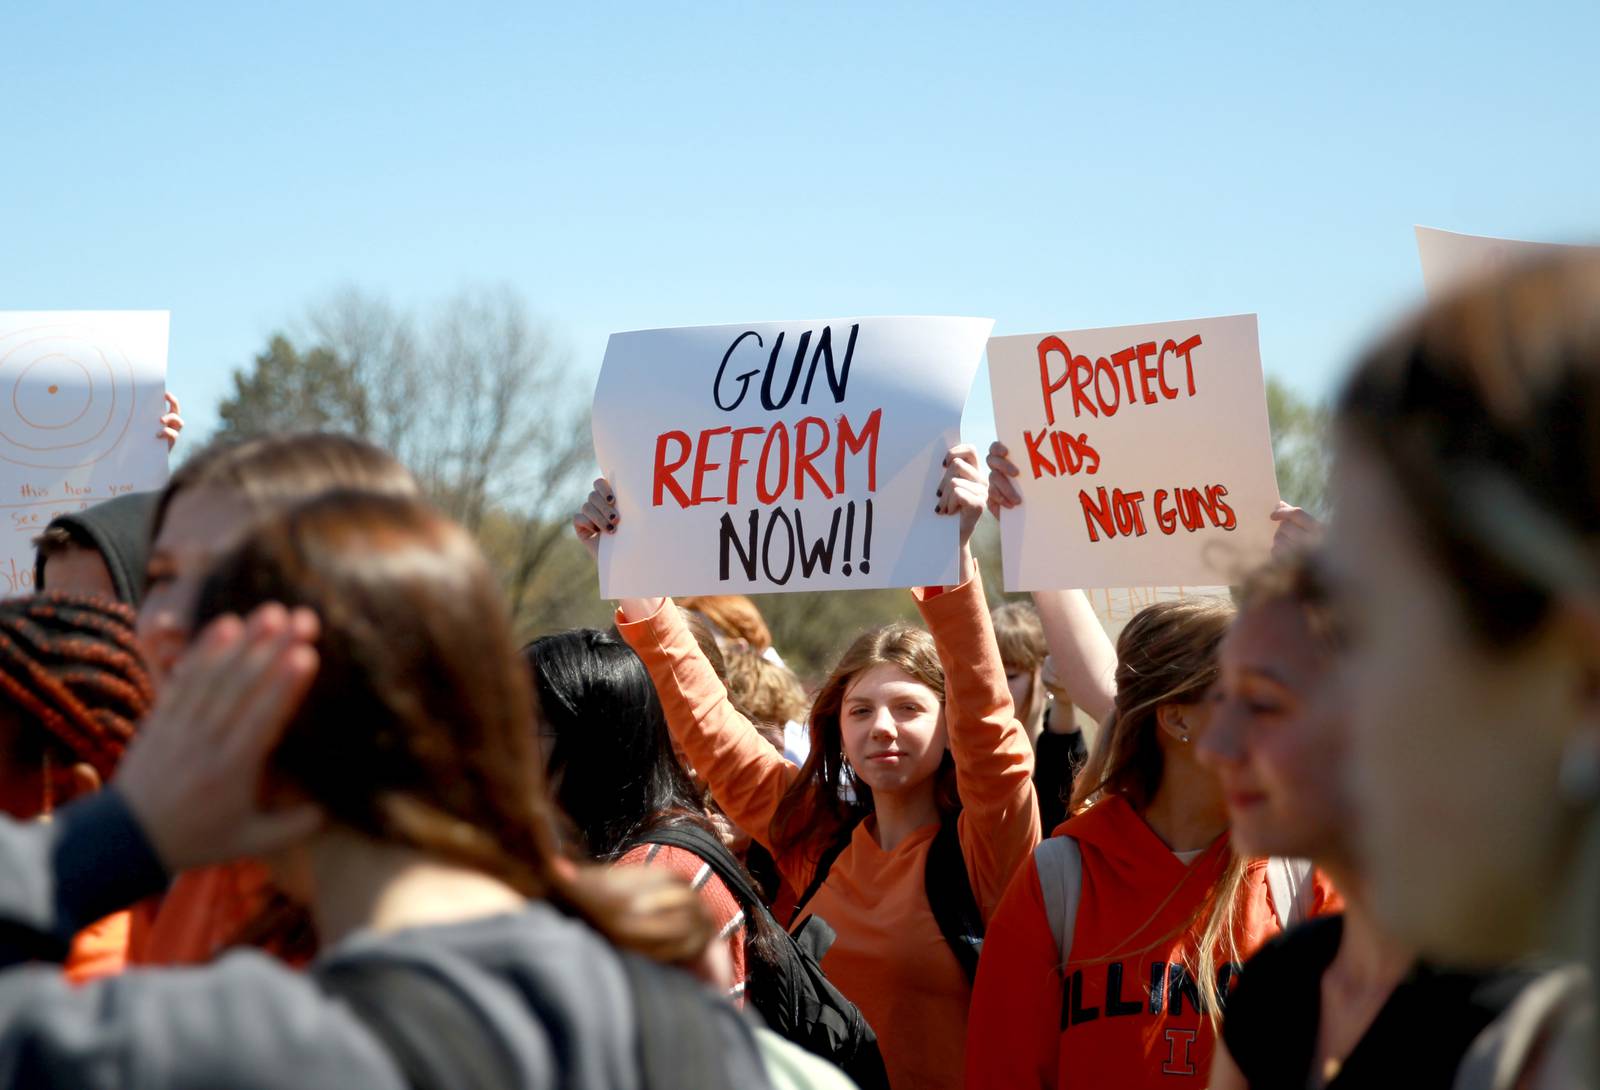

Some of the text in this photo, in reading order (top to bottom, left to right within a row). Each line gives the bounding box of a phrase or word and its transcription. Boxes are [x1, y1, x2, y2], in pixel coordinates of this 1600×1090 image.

[713, 323, 859, 411] GUN
[1036, 334, 1203, 426] PROTECT
[652, 408, 882, 509] REFORM
[1023, 427, 1100, 480] KIDS
[719, 498, 872, 585] NOW!!
[1078, 484, 1237, 542] NOT GUNS
